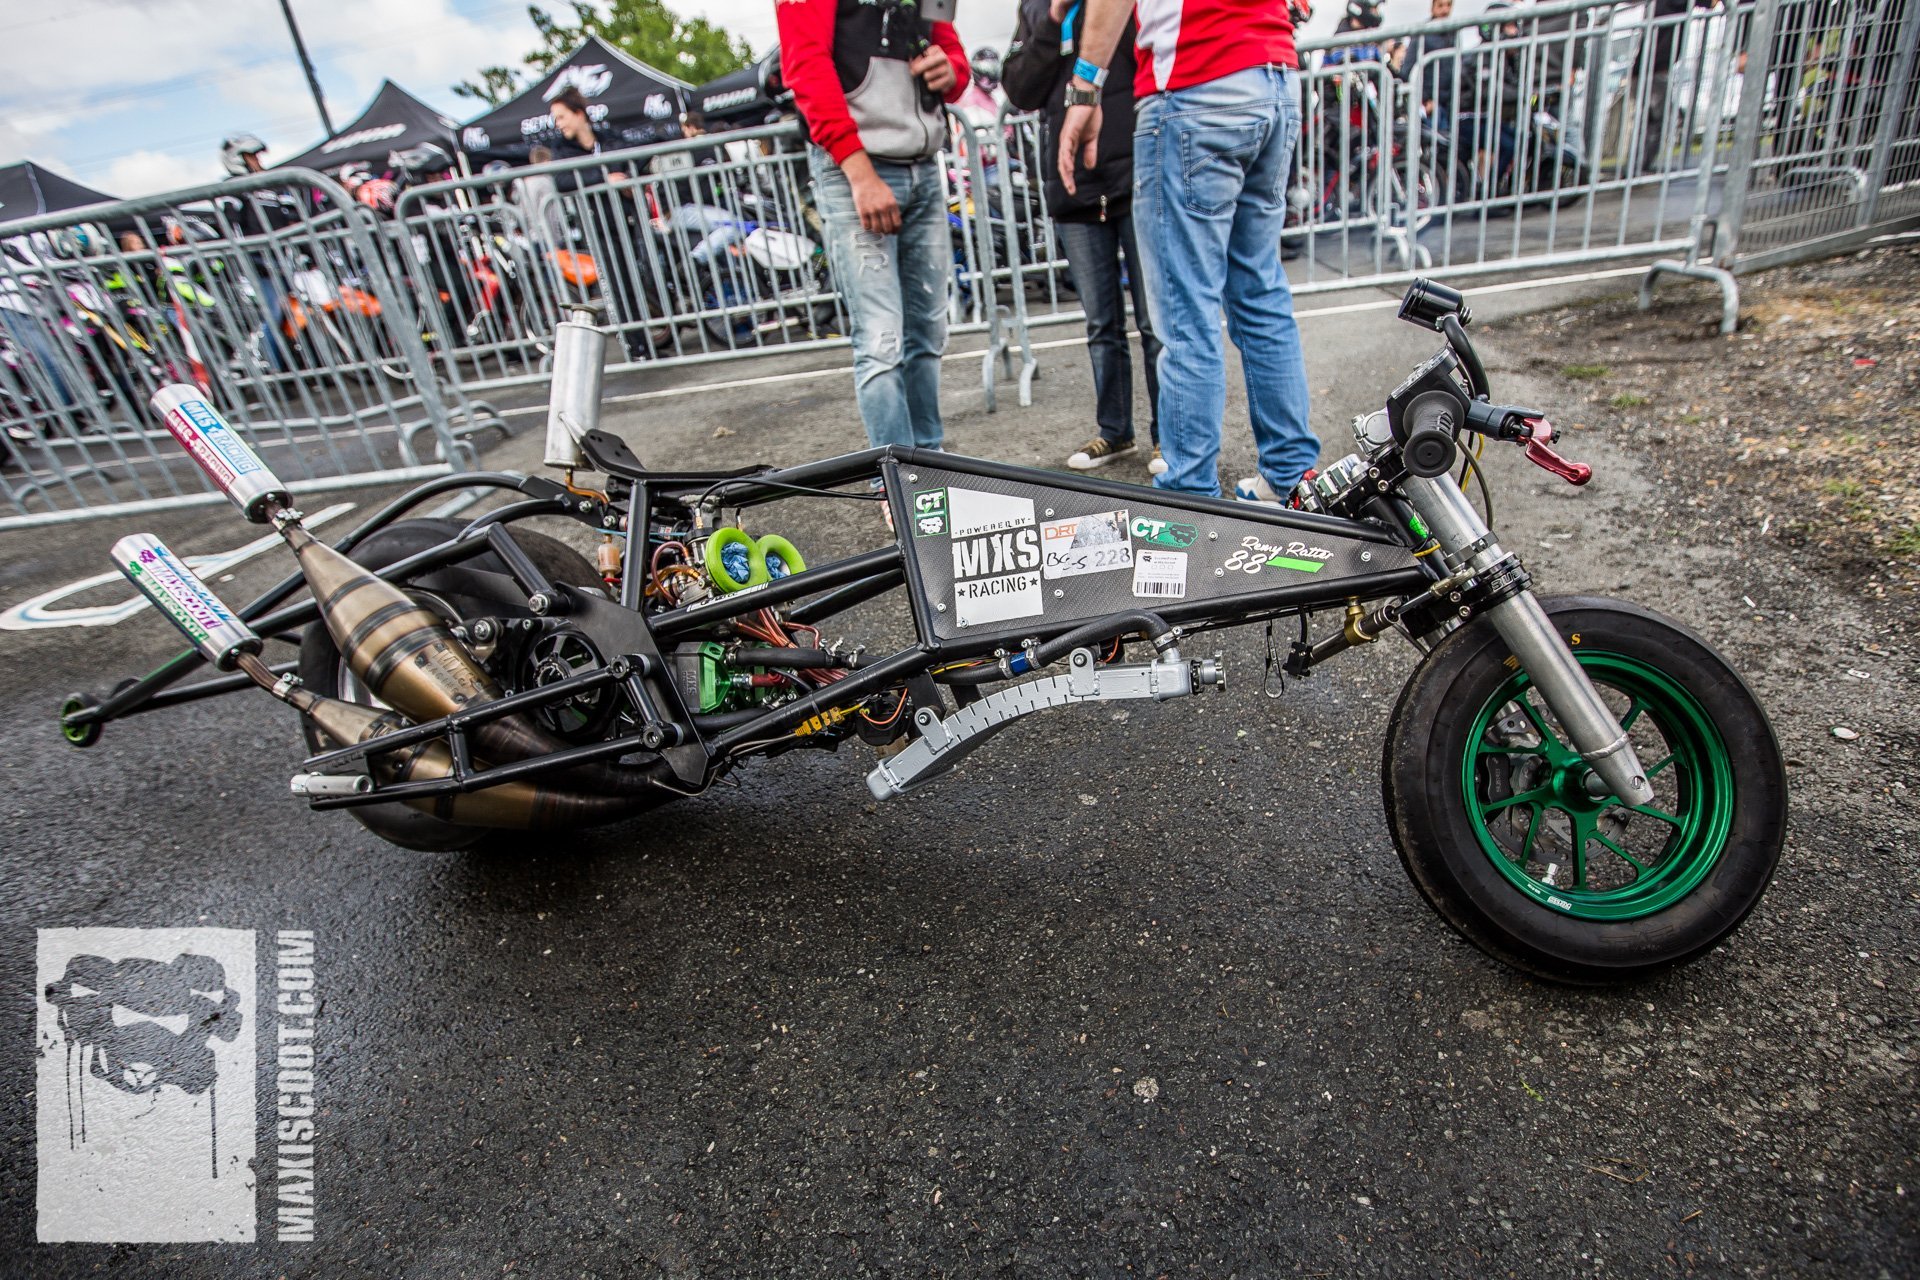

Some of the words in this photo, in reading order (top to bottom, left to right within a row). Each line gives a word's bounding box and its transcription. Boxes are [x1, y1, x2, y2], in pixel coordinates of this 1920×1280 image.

[915, 491, 943, 511] CT
[1130, 517, 1166, 540] CT
[952, 528, 1041, 579] MXS
[1094, 547, 1131, 567] 228
[1241, 535, 1283, 561] Remy
[1224, 550, 1268, 574] 88
[969, 575, 1027, 599] RACING
[1571, 633, 1581, 645] S
